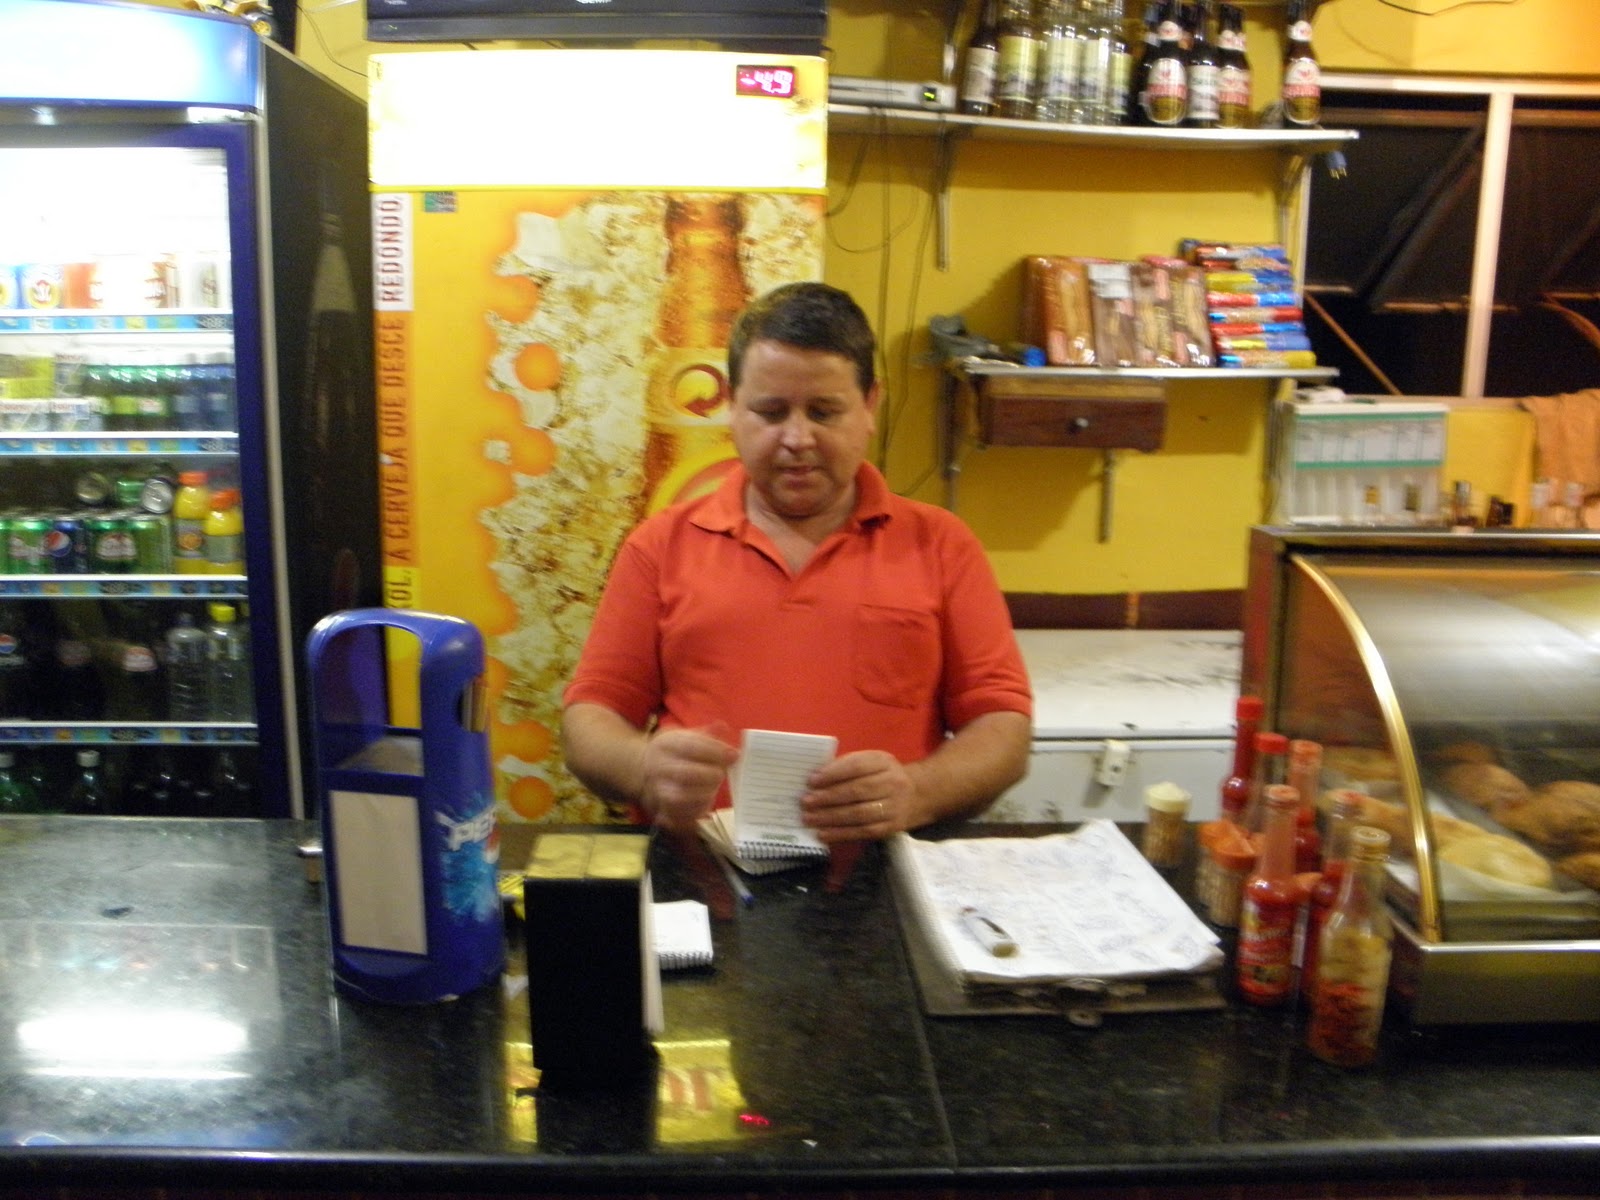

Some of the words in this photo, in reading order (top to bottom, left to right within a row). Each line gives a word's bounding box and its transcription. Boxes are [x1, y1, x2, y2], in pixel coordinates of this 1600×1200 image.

[380, 319, 406, 388] DESCE
[382, 399, 406, 438] QUE
[382, 447, 409, 540] CERVEJA
